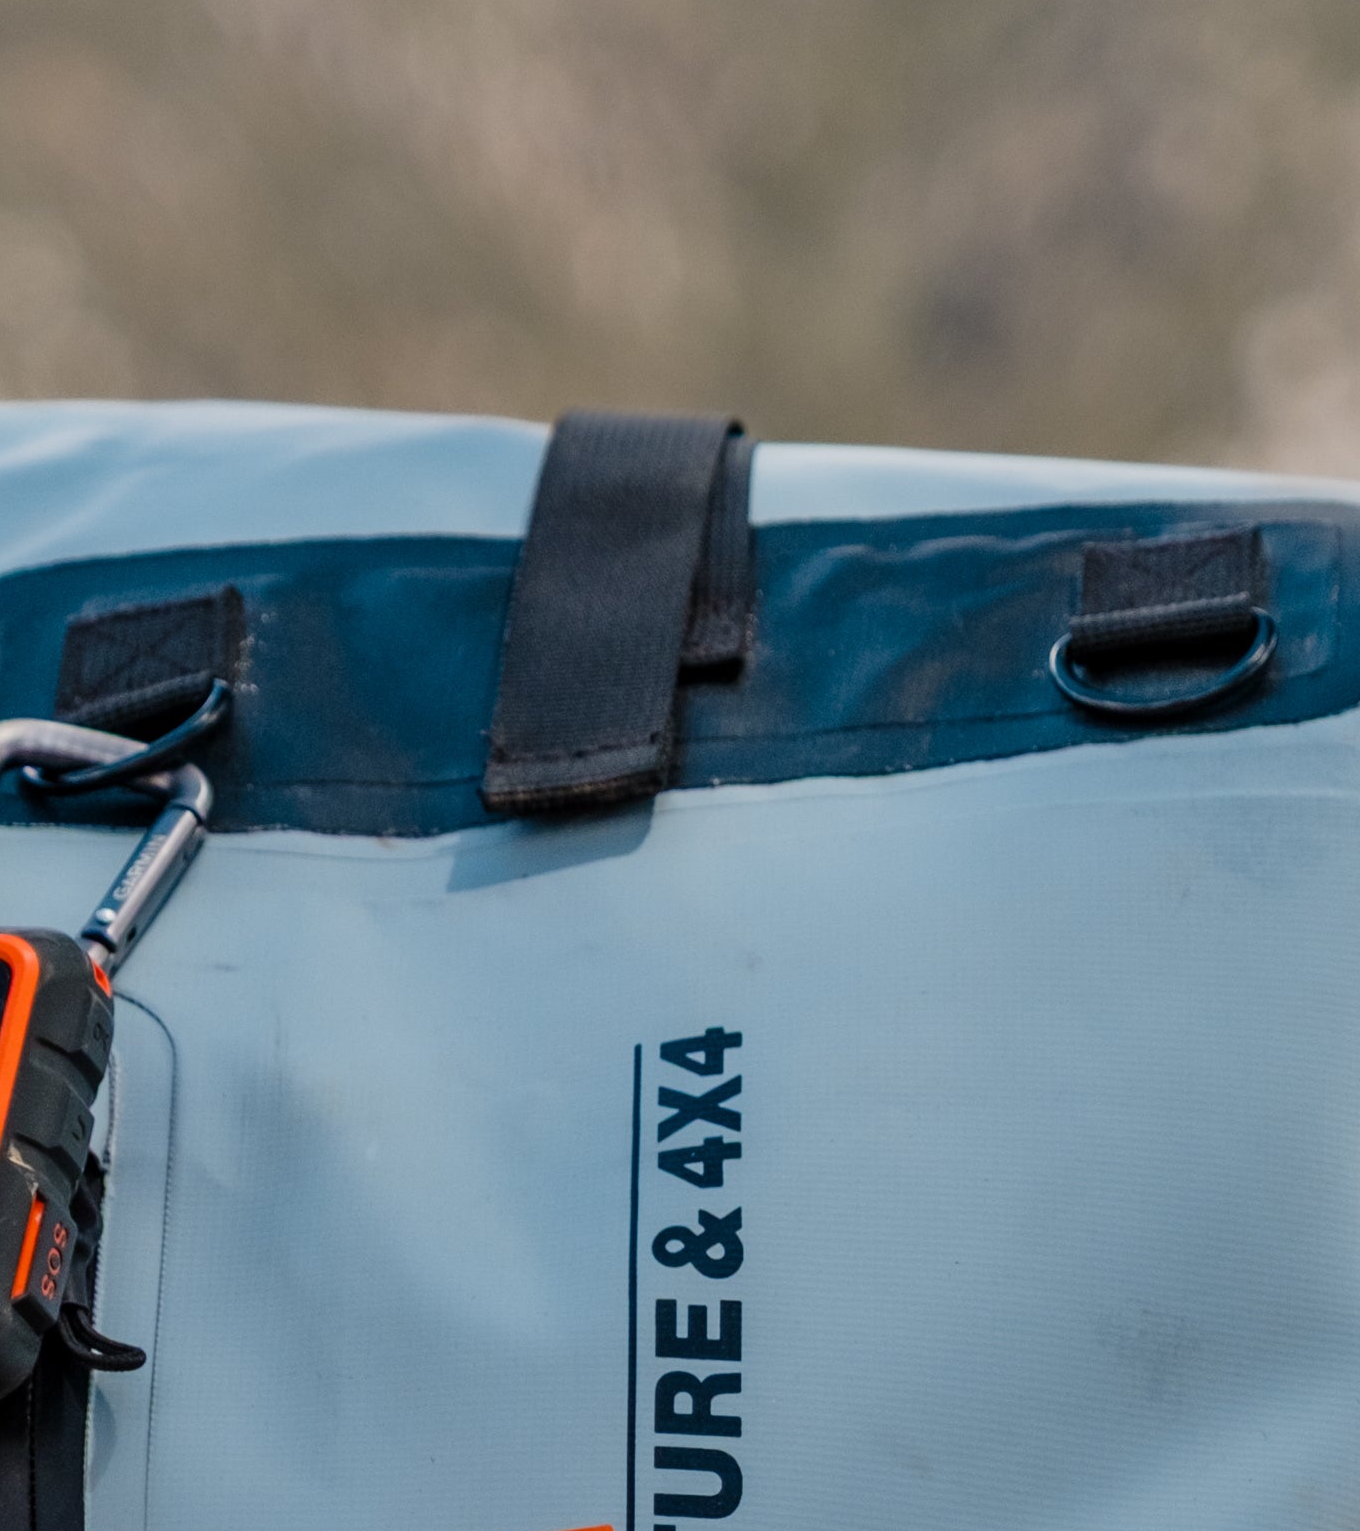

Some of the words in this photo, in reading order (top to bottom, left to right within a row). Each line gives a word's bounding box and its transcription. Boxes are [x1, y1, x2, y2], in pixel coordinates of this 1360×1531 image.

[656, 1026, 743, 1189] 4X4
[40, 1221, 68, 1301] SOS
[651, 1206, 744, 1280] &
